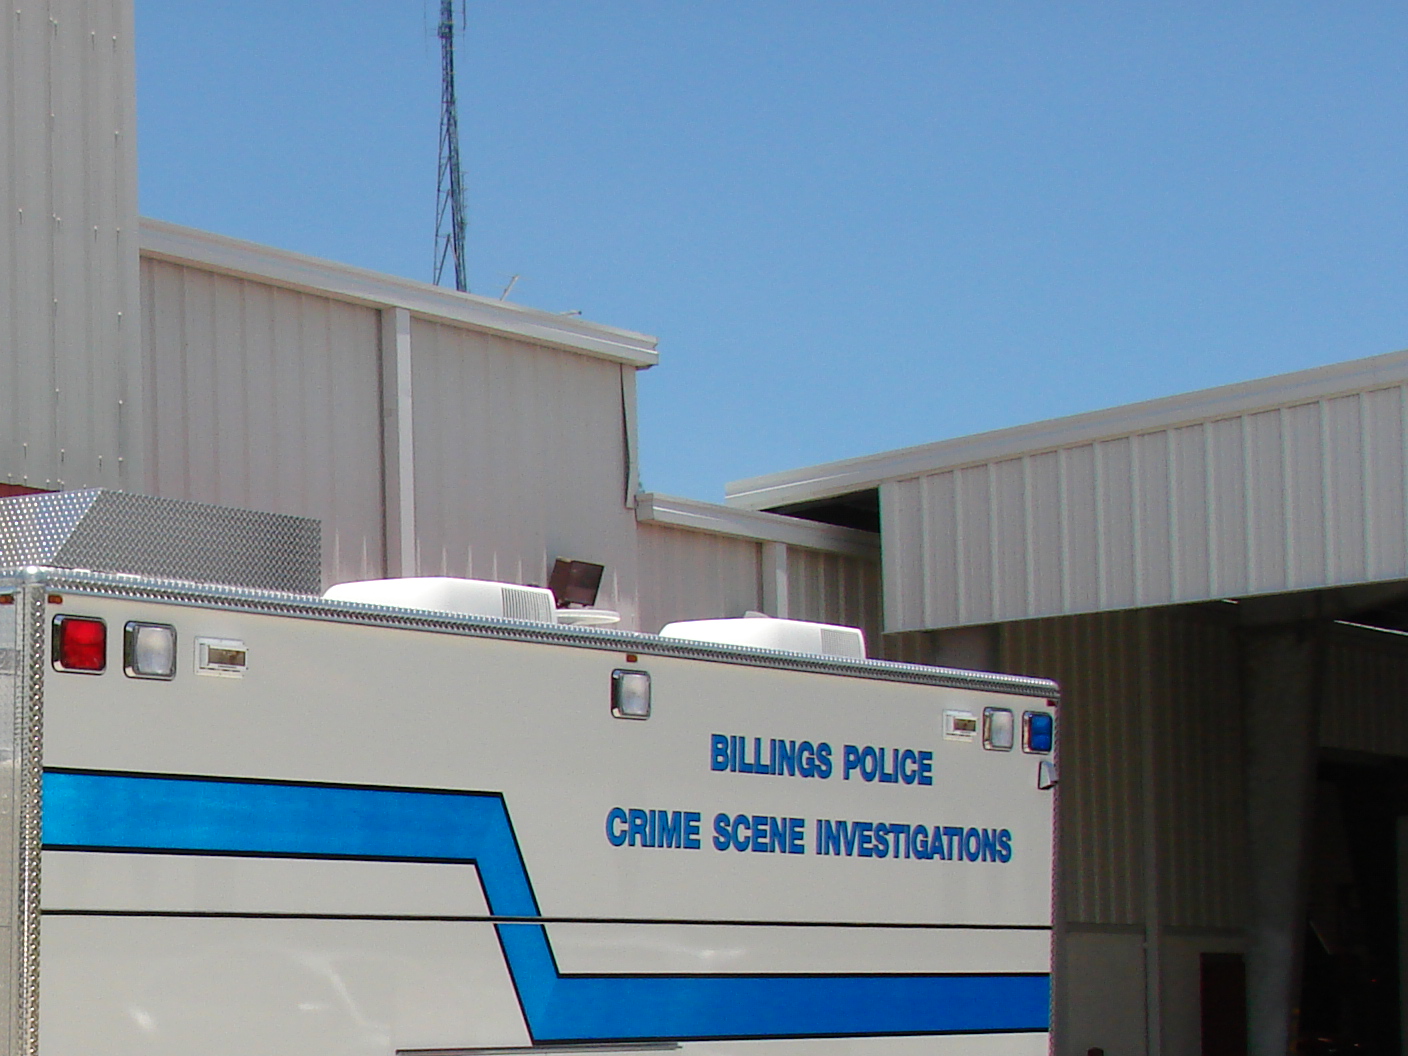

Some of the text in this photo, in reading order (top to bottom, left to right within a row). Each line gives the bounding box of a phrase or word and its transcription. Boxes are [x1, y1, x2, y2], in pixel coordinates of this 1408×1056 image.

[709, 733, 934, 786] BILLINGS POLICE
[605, 806, 1013, 864] CRIME SCENE INVESTIGATIONS
